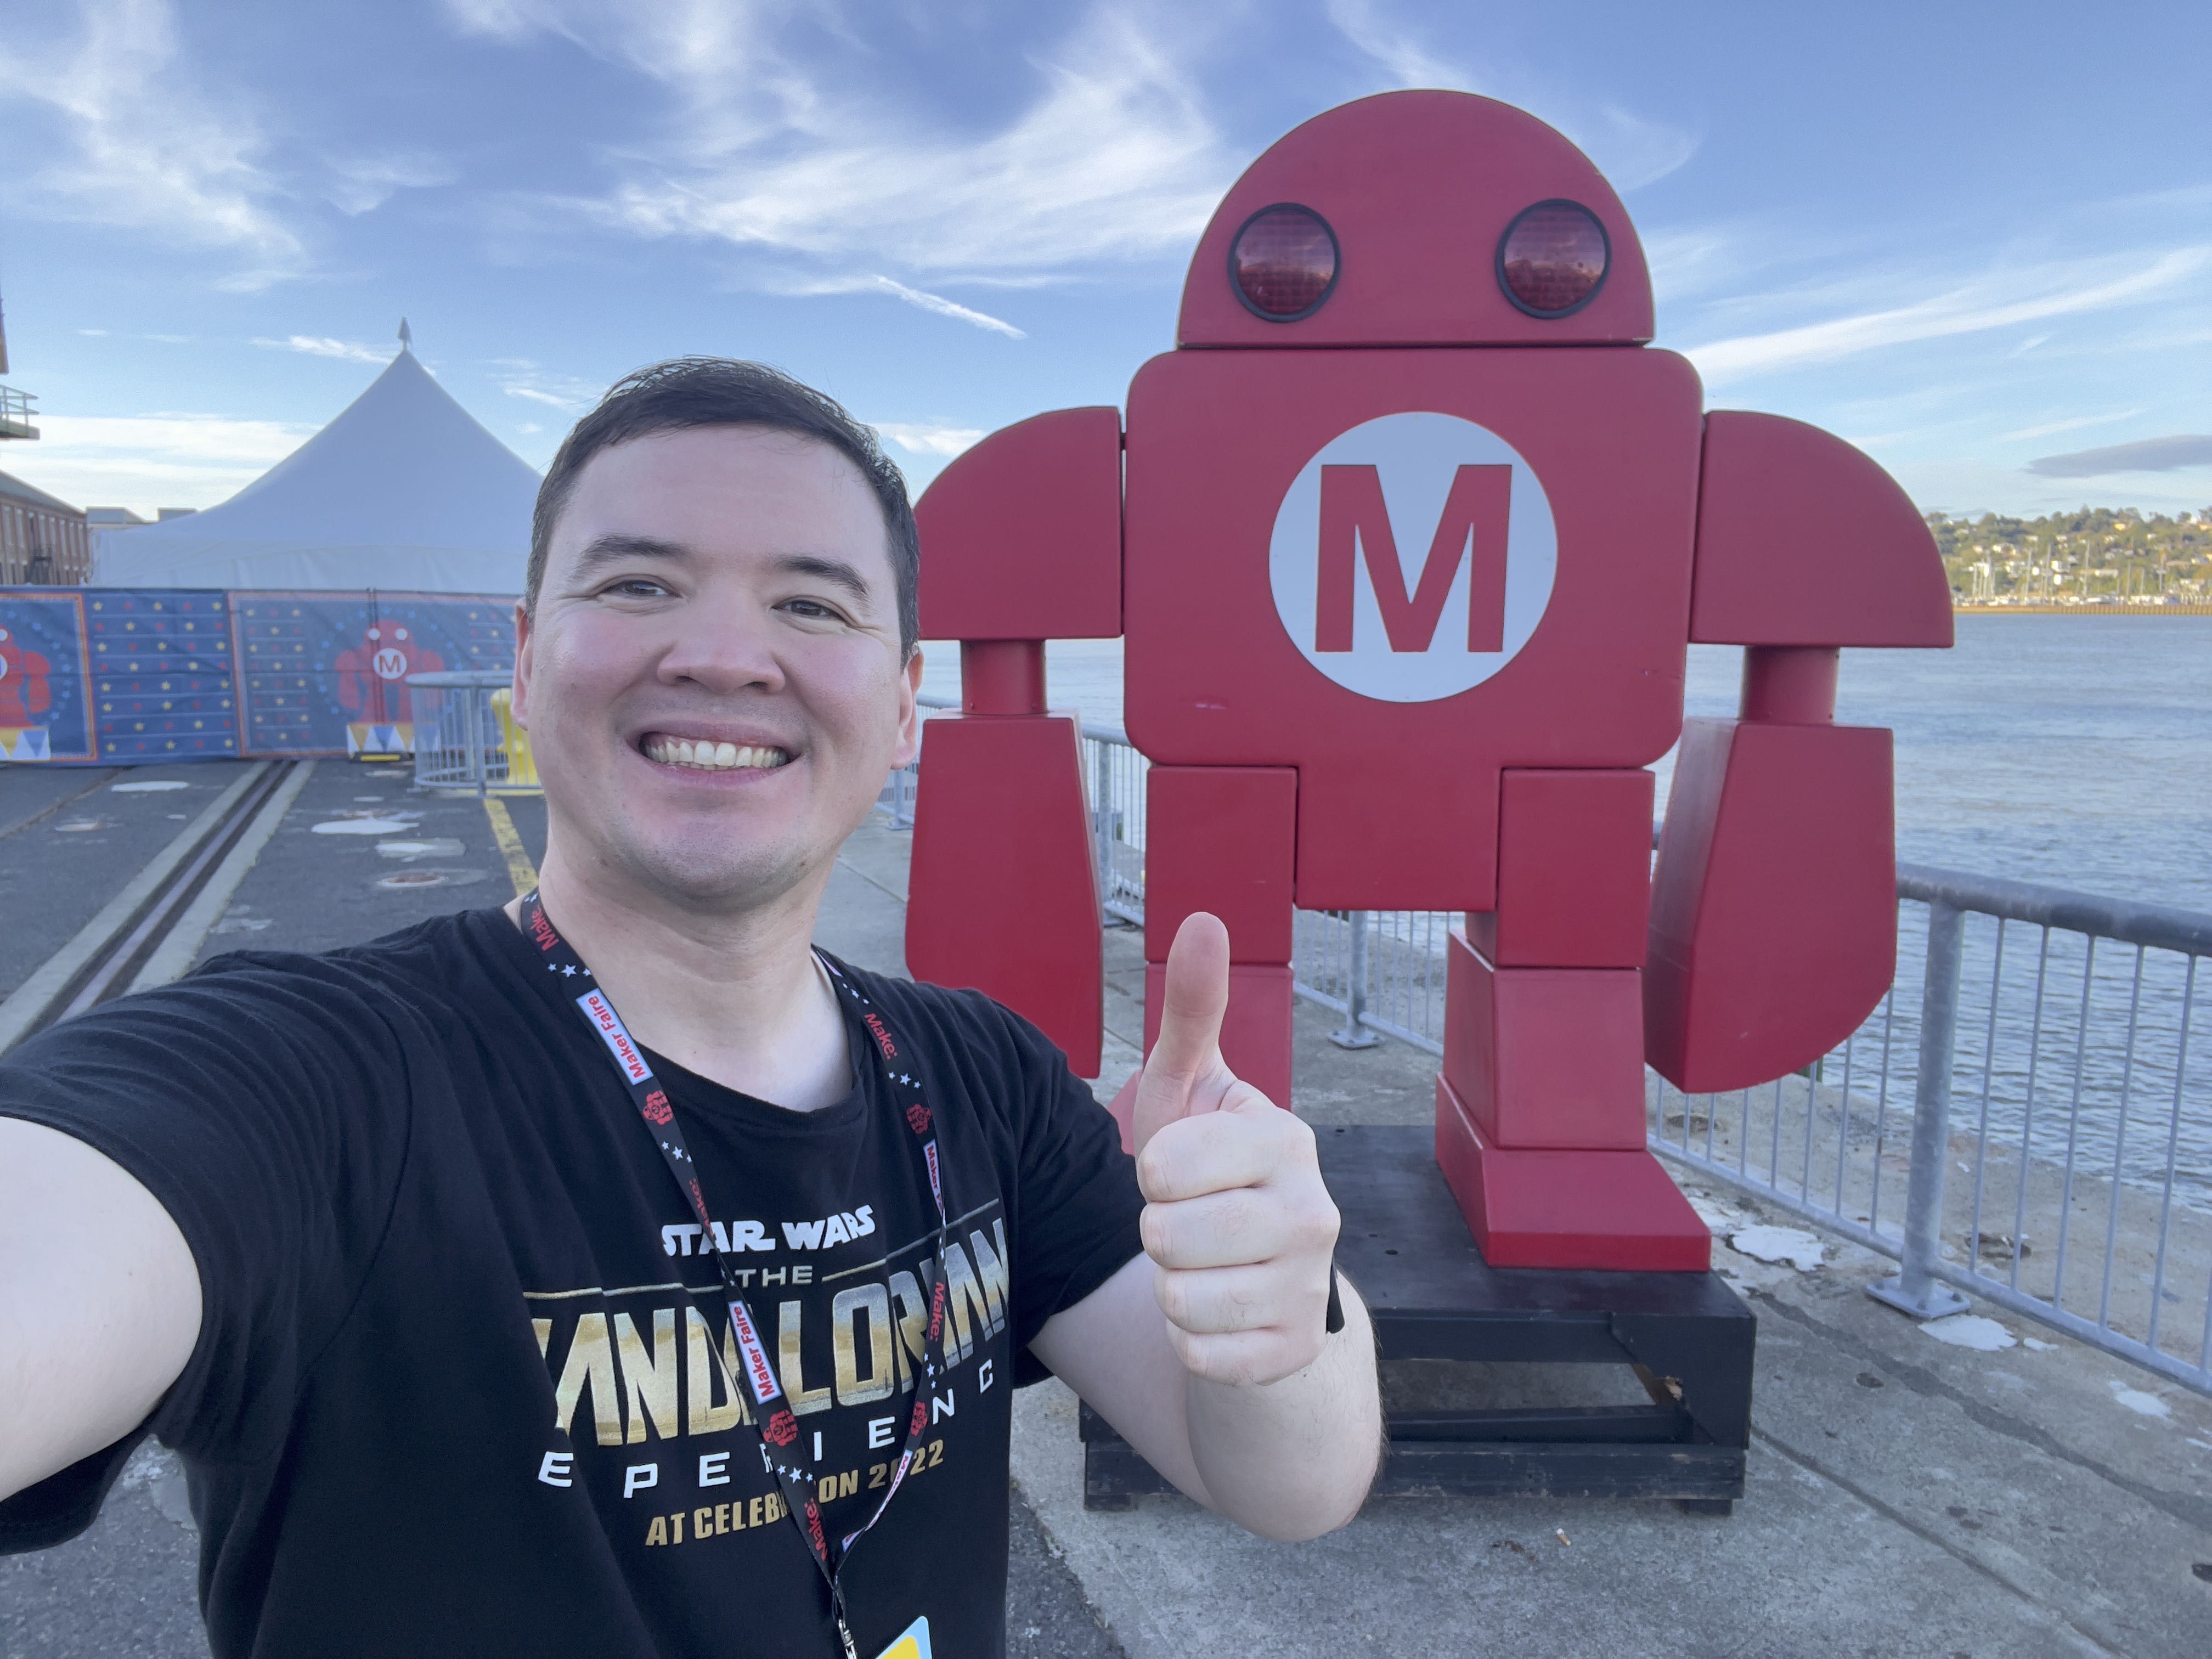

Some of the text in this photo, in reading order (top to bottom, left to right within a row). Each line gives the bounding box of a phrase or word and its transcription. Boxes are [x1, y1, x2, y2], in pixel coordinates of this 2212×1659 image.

[1315, 464, 1513, 652] M
[379, 654, 400, 673] M
[588, 995, 646, 1079] Maker Faire
[864, 1013, 898, 1060] Make:
[927, 1146, 939, 1189] Maker
[662, 1205, 876, 1256] STAR WARS
[735, 1265, 813, 1288] THE
[930, 1282, 945, 1342] Make:
[734, 1305, 775, 1398] Maker Faire
[645, 1513, 686, 1546] AT
[804, 1497, 827, 1561] Make:
